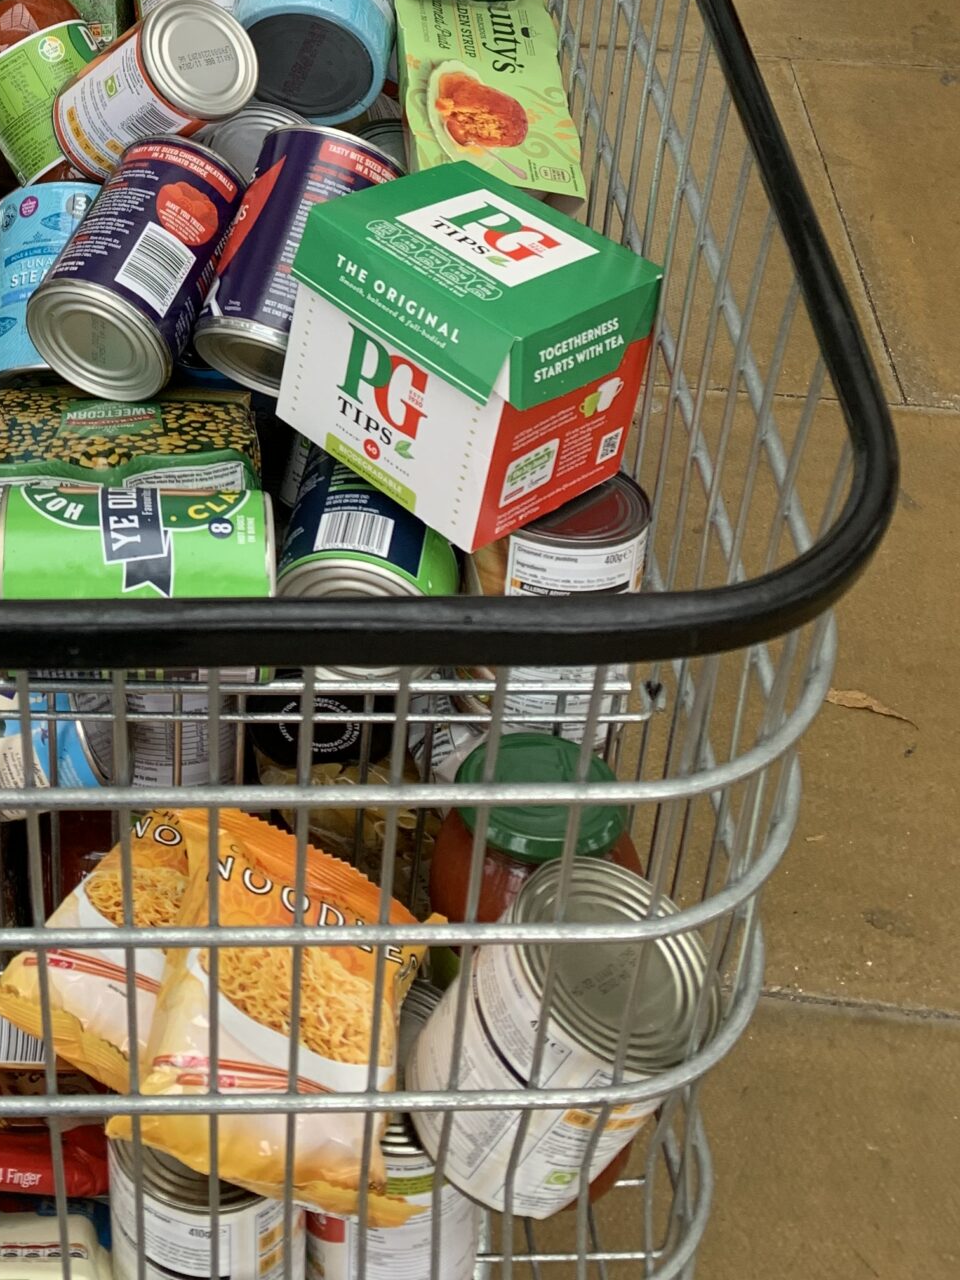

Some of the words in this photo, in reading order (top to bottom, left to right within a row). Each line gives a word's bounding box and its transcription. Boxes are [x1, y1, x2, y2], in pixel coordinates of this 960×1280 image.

[460, 28, 477, 58] SYRUP
[482, 5, 525, 74] unty's
[161, 146, 178, 156] SIZED
[178, 151, 205, 167] CHICKEN
[205, 163, 234, 191] MEATBALLS
[165, 153, 189, 169] TOMATO
[189, 162, 208, 178] SAUCE
[329, 144, 349, 158] TASTY
[350, 151, 364, 164] BITE
[364, 157, 382, 173] SIZED
[75, 197, 87, 210] 3
[165, 200, 180, 212] HAVE
[180, 208, 190, 219] YOU
[431, 219, 490, 255] TIPS
[439, 201, 561, 261] PG
[20, 257, 52, 270] TUNA
[336, 254, 367, 283] THE
[373, 279, 460, 344] ORIGINAL
[339, 275, 366, 298] Smooth,
[367, 293, 398, 318] balanced
[405, 317, 447, 349] full-bodied
[539, 317, 620, 363] TOGETHERNESS
[533, 357, 575, 383] STARTS
[575, 345, 605, 363] WITH
[605, 334, 625, 352] TEA
[336, 322, 429, 440] PG
[66, 406, 156, 420] SWEETCORN
[337, 396, 393, 446] TIPS
[365, 442, 378, 456] 40
[340, 444, 403, 494] BIODEGRADABLE
[33, 489, 86, 521] HOT
[110, 515, 142, 552] YE
[541, 551, 554, 559] rice
[555, 554, 578, 565] pudding
[604, 552, 623, 567] 400g
[6, 1168, 42, 1187] Finger
